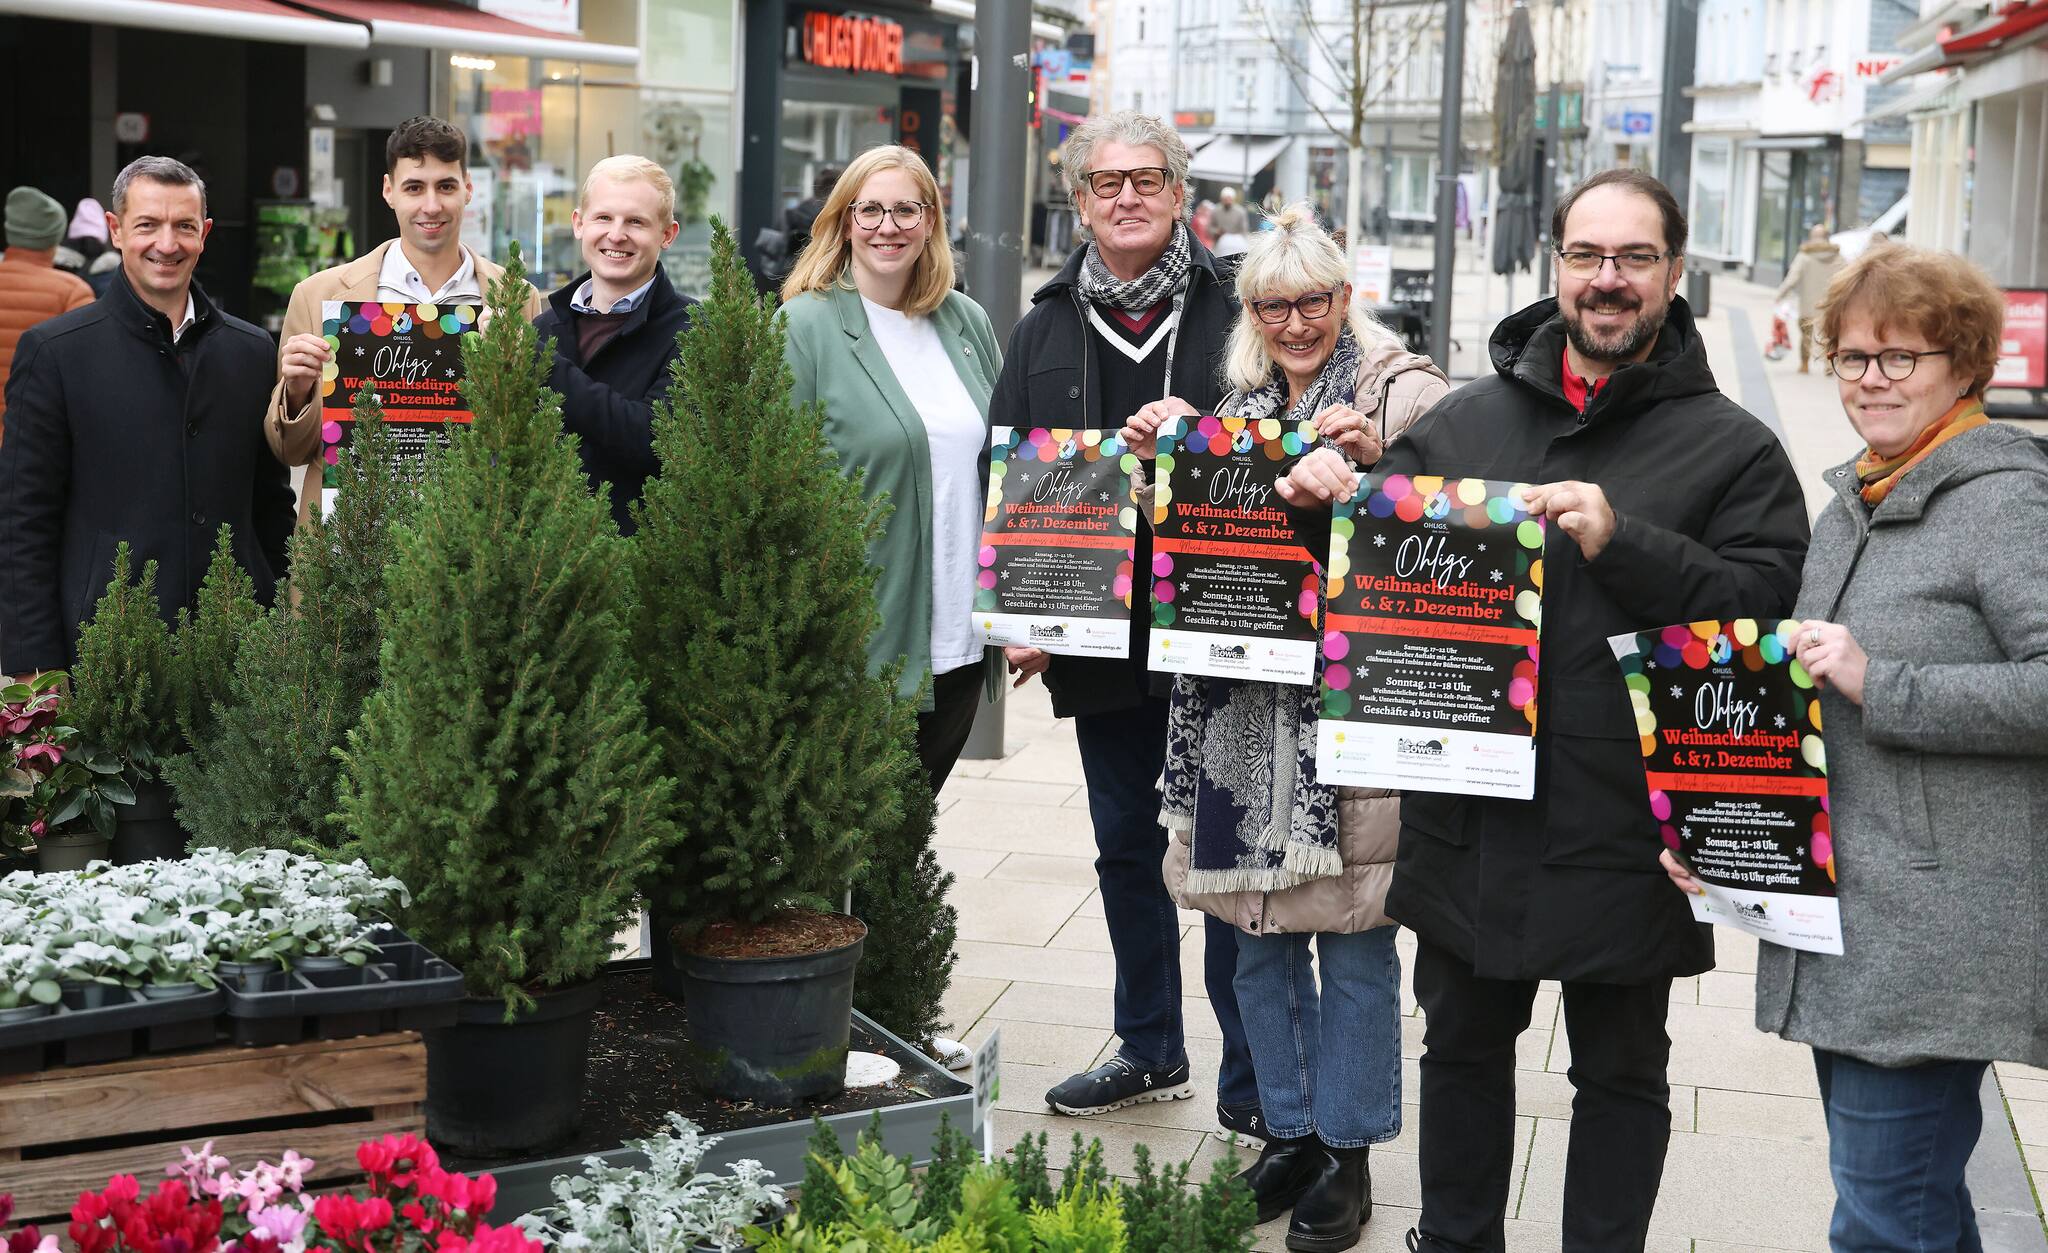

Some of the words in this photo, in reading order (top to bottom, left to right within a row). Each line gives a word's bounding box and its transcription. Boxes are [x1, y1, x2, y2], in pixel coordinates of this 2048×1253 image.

[373, 344, 432, 385] Ohligs
[390, 393, 456, 405] Dezember
[1034, 471, 1088, 509] Ohligs
[1209, 467, 1272, 515] Ohligs
[1005, 503, 1118, 522] Weihnachtsdürpel
[1007, 518, 1016, 527] 6.
[1019, 517, 1030, 527] &
[1030, 519, 1040, 528] 7.
[1043, 517, 1108, 530] Dezember
[1181, 522, 1192, 532] 6.
[1196, 522, 1207, 534] &
[1210, 524, 1220, 535] 7.
[1224, 523, 1293, 538] Dezember
[1396, 534, 1473, 589] Ohligs
[1021, 576, 1051, 587] Sonntag,
[1071, 578, 1085, 587] Uhr
[1355, 575, 1515, 601] Weihnachtsdürpel
[1202, 591, 1234, 602] Sonntag,
[1255, 594, 1269, 602] Uhr
[1070, 602, 1099, 612] geöffnet
[1360, 596, 1374, 609] 6.
[1378, 596, 1393, 610] &
[1396, 600, 1409, 612] 7.
[1414, 598, 1501, 619] Dezember
[1184, 615, 1218, 624] Geschäfte
[1253, 620, 1283, 632] geöffnet
[1375, 648, 1414, 657] Musikalischer
[1372, 686, 1417, 696] Weihnachtlicher
[1385, 676, 1426, 690] Sonntag,
[1453, 681, 1470, 690] Uhr
[1418, 699, 1455, 707] Kulinarisches
[1695, 682, 1759, 739] Ohligs
[1363, 704, 1407, 716] Geschäfte
[1409, 708, 1420, 717] ab
[1432, 710, 1450, 719] Uhr
[1452, 711, 1489, 725] geöffnet
[1662, 728, 1799, 749] Weihnachtsdürpel
[1410, 746, 1432, 754] OWG
[1673, 751, 1685, 765] 6.
[1688, 750, 1700, 766] &
[1702, 754, 1714, 767] 7.
[1718, 752, 1791, 768] Dezember
[1705, 835, 1740, 850] Sonntag,
[1762, 838, 1778, 849] Uhr
[1697, 866, 1729, 877] Geschäfte
[1731, 869, 1740, 878] ab
[1740, 873, 1752, 882] 13
[1752, 871, 1766, 881] Uhr
[1766, 872, 1799, 886] geöffnet
